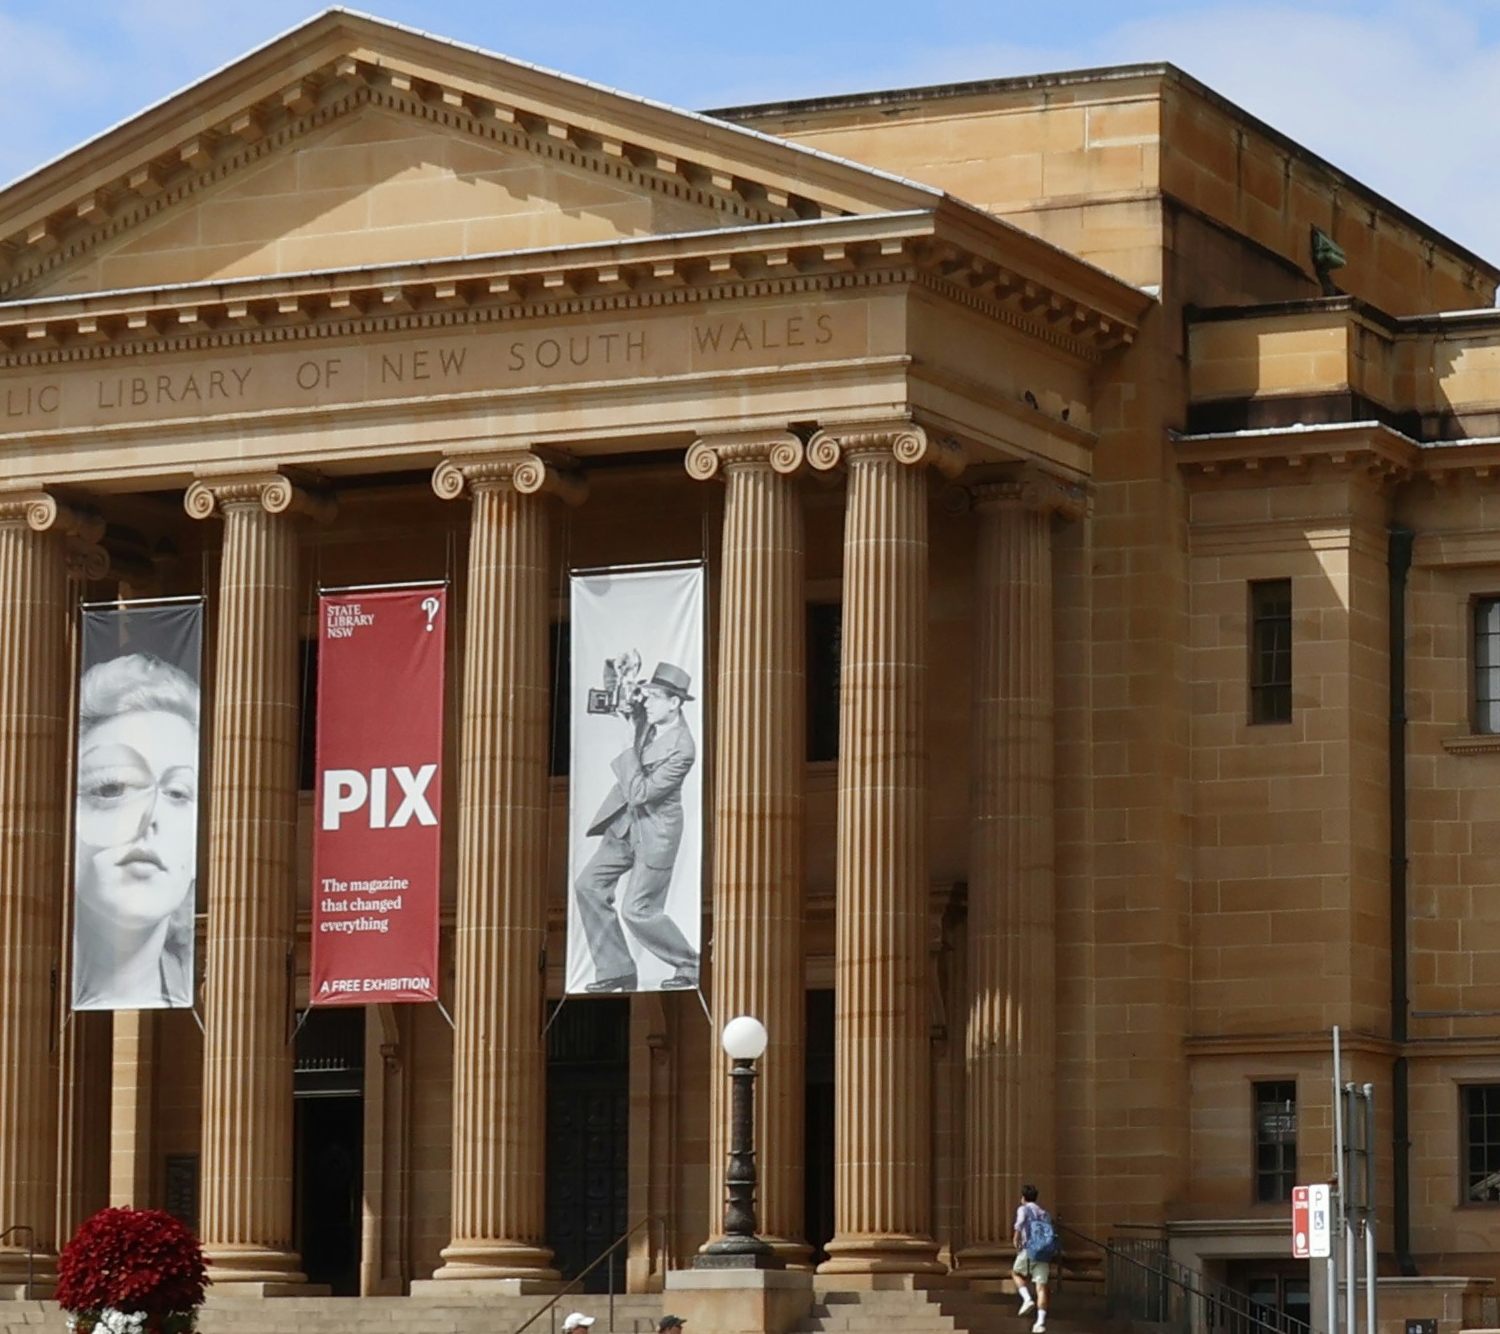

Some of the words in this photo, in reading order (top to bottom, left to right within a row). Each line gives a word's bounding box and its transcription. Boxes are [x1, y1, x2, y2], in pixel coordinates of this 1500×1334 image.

[99, 367, 253, 409] LIBRARY
[296, 359, 342, 390] OF
[381, 347, 467, 383] NEW
[508, 330, 646, 372] SOUTH
[695, 314, 834, 353] WALES
[327, 604, 361, 616] STATE
[327, 614, 374, 627] LIBRARY
[327, 627, 353, 638] NSW
[322, 764, 439, 830] PIX
[322, 879, 348, 893] The
[350, 876, 409, 894] magazine
[321, 898, 348, 912] that
[350, 896, 402, 912] changed
[320, 916, 389, 935] everything
[320, 980, 330, 993] A
[332, 979, 361, 992] FREE
[363, 977, 430, 992] EXHIBITION
